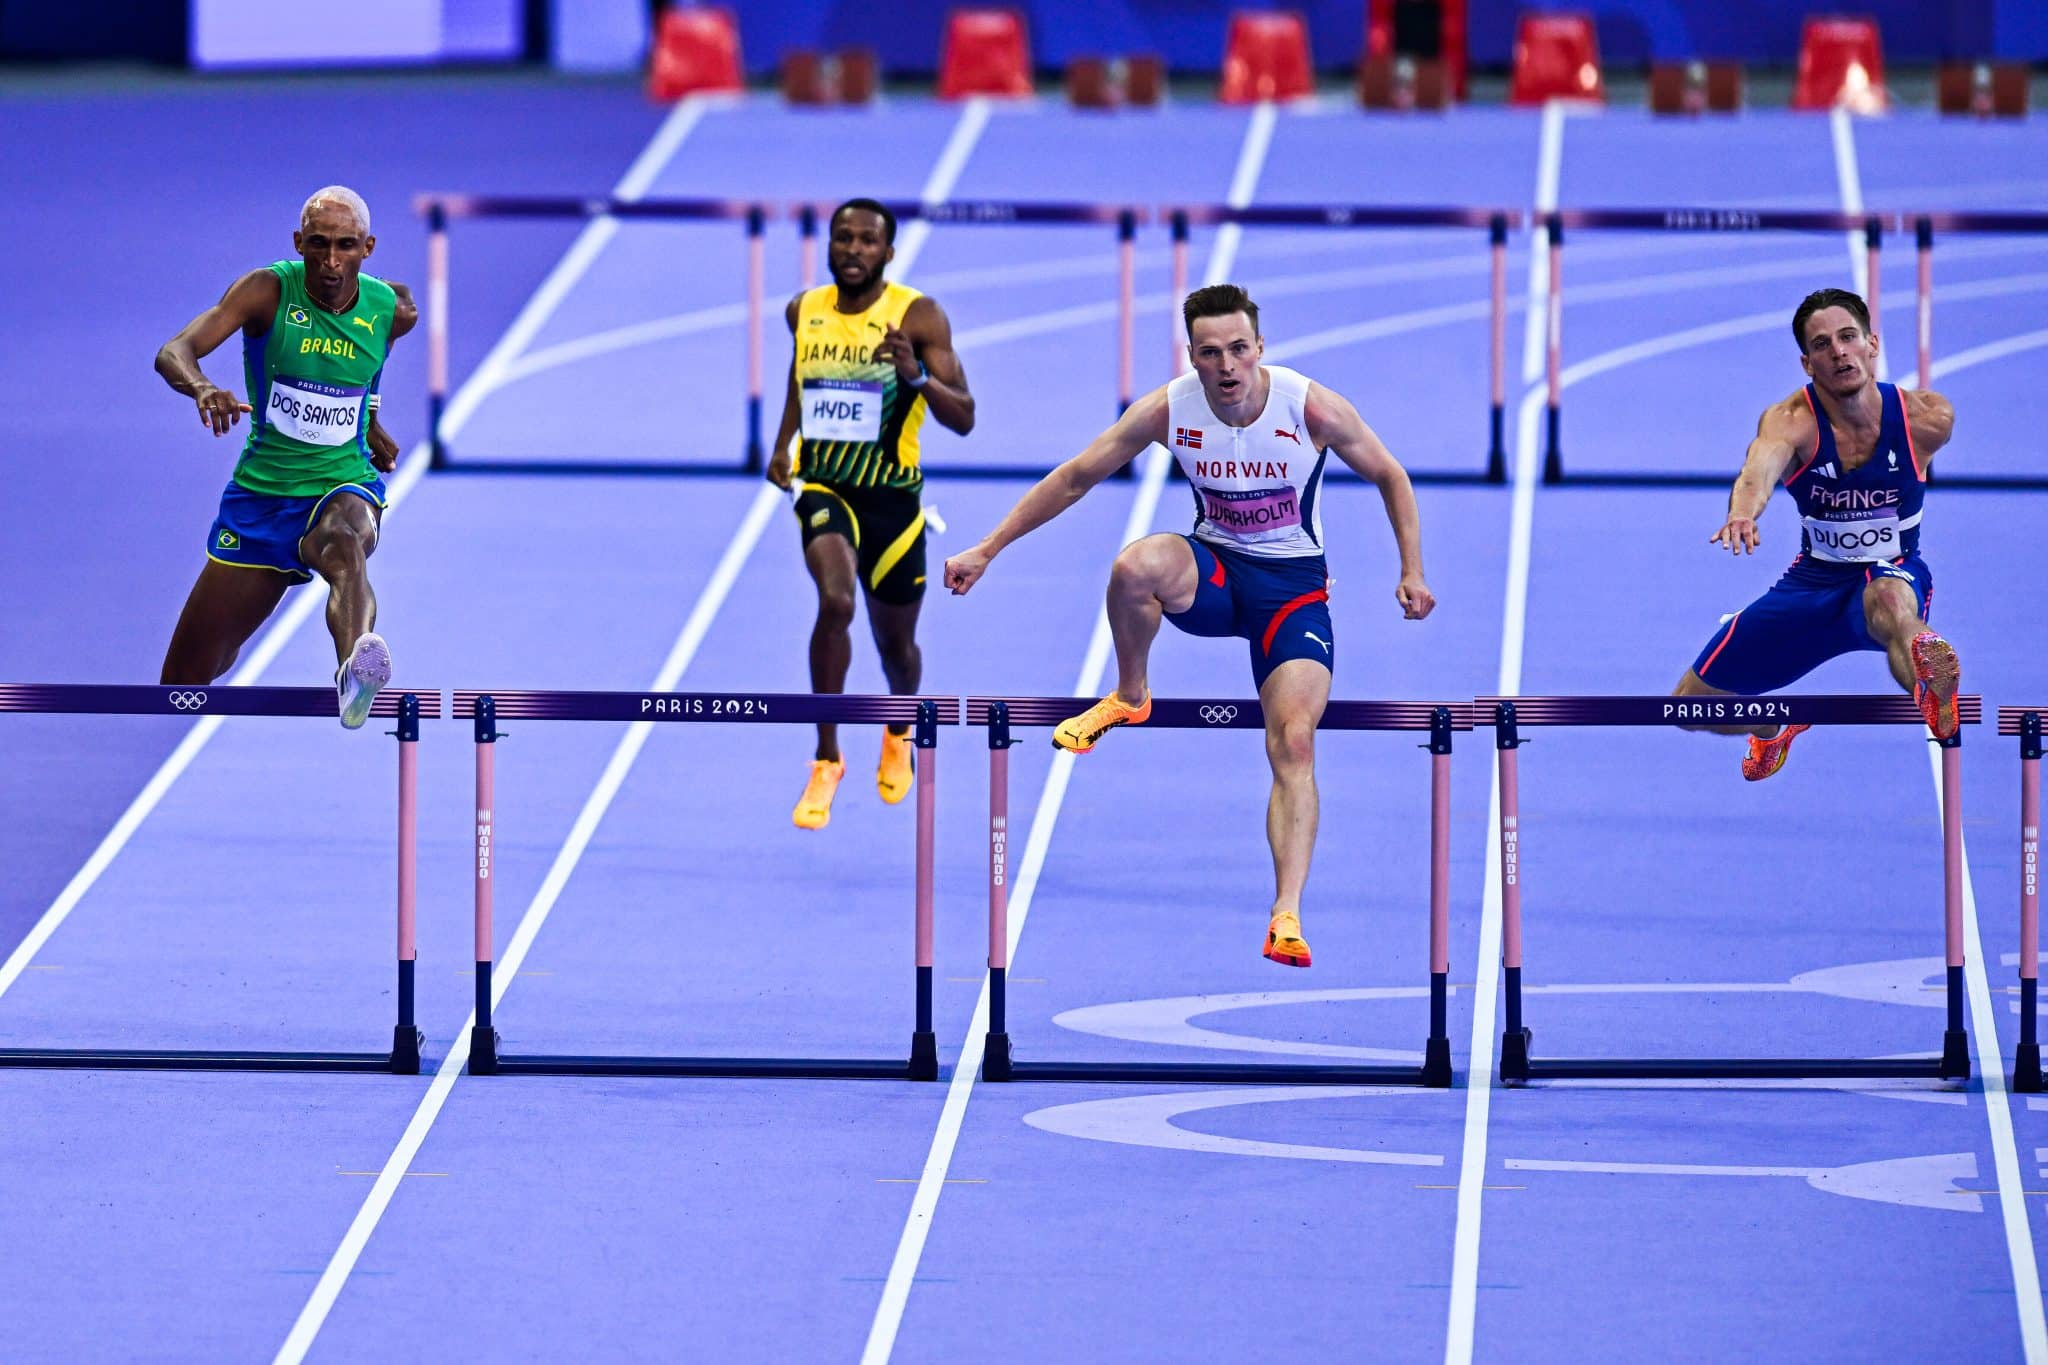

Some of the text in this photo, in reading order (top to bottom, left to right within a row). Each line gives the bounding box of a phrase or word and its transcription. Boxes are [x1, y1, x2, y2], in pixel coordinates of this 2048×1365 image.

[300, 338, 356, 359] BRASIL
[298, 381, 322, 391] PARIS
[271, 391, 356, 426] DOS SANTOS
[813, 400, 864, 421] HYDE
[1196, 461, 1288, 479] NORWAY
[1810, 484, 1899, 509] FRANCE
[1208, 499, 1296, 527] WARHOLM
[1813, 526, 1893, 549] DUCOS
[641, 698, 768, 715] PARIS 2024
[1663, 702, 1790, 718] PARIS 2024
[478, 825, 491, 879] MONDO
[992, 831, 1006, 886] MONDO
[1504, 831, 1518, 885] MONDO
[2024, 842, 2038, 896] MONDO
